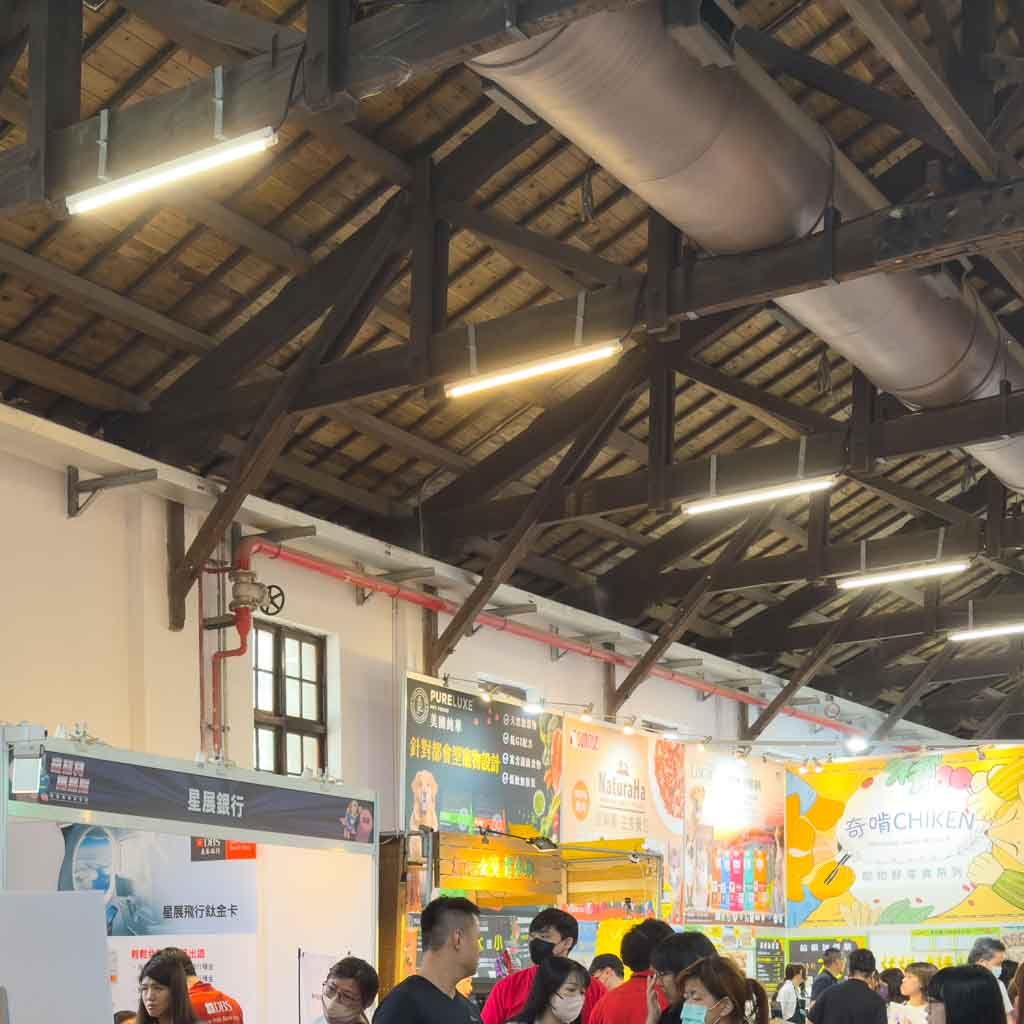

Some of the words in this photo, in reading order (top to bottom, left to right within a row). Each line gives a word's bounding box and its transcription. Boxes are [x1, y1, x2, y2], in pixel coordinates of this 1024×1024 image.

[429, 689, 473, 712] PURELUXE
[187, 787, 245, 819] 星展銀行
[162, 903, 239, 920] 星展飛行鈦金卡
[212, 1001, 233, 1014] DBS
